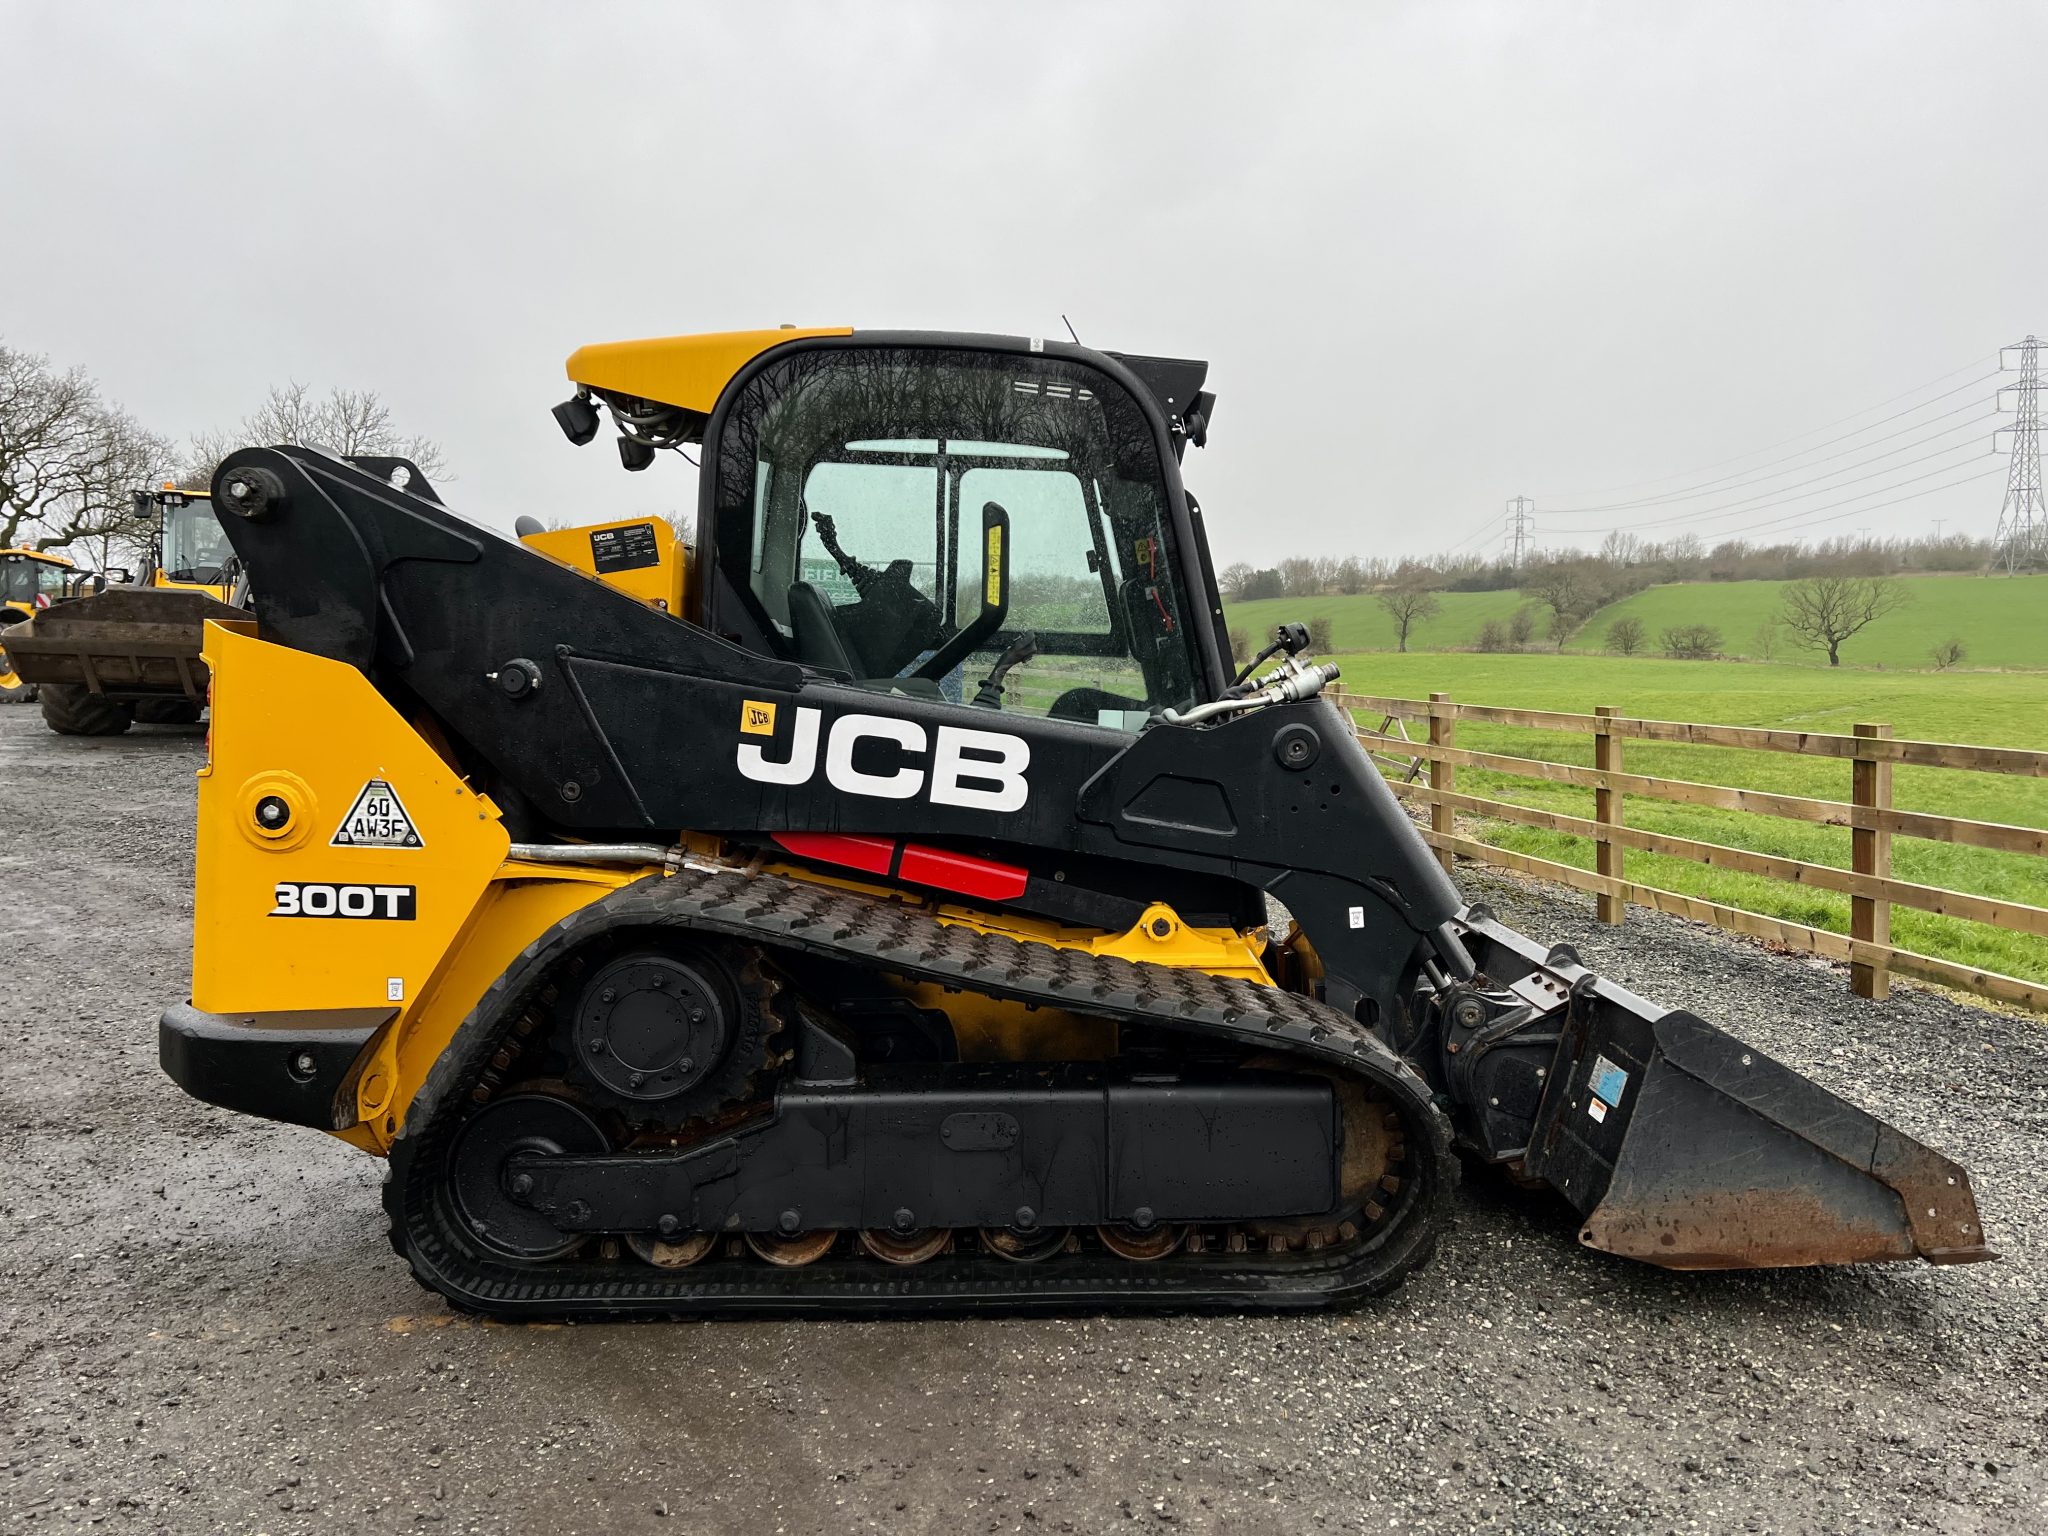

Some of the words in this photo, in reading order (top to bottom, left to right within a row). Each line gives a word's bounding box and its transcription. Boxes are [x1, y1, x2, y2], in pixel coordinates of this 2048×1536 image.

[593, 532, 615, 542] JCB
[750, 709, 769, 725] JCB
[737, 707, 1030, 812] JCB
[353, 818, 404, 838] AW3F
[271, 884, 410, 918] 300T
